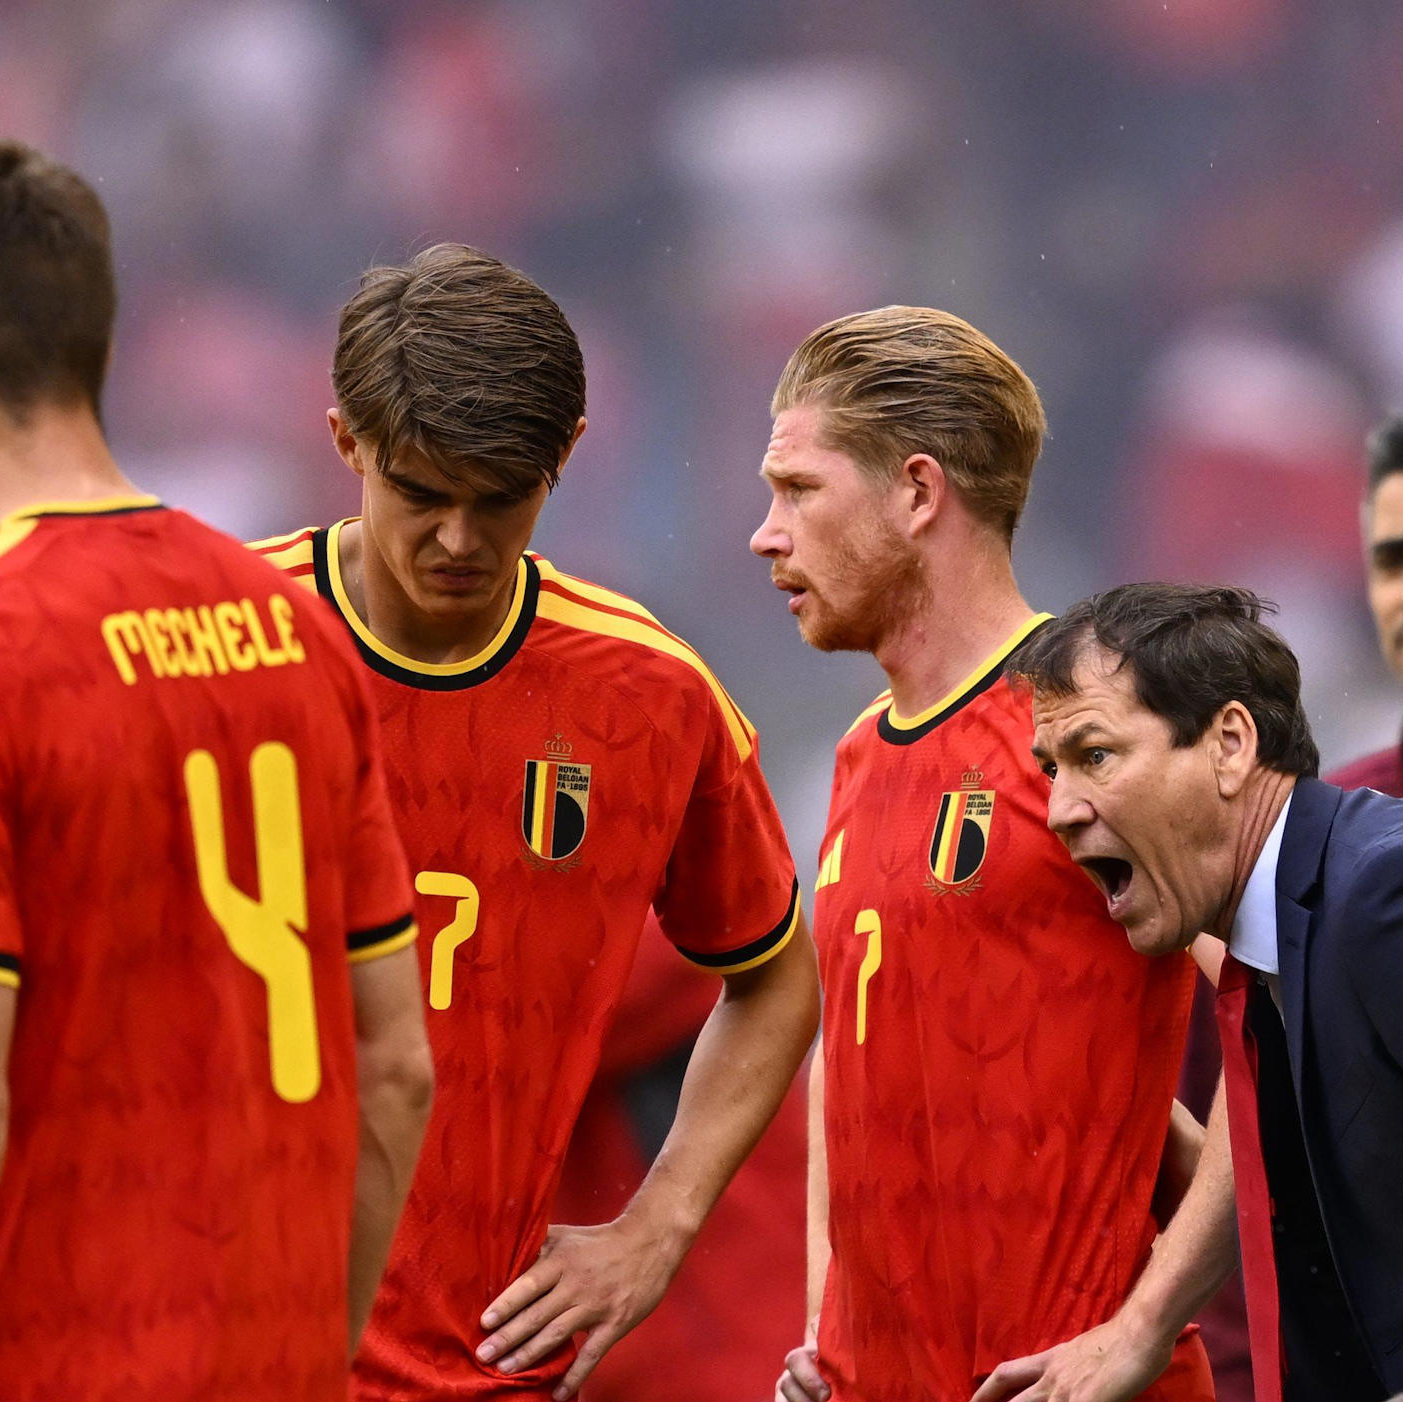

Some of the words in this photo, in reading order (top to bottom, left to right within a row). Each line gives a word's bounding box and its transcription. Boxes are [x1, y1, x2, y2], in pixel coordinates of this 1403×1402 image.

[102, 594, 306, 686] MECHELE
[557, 774, 589, 783] BELGIAN
[558, 765, 582, 775] ROYAL
[185, 742, 321, 1104] 4
[854, 908, 882, 1046] 7
